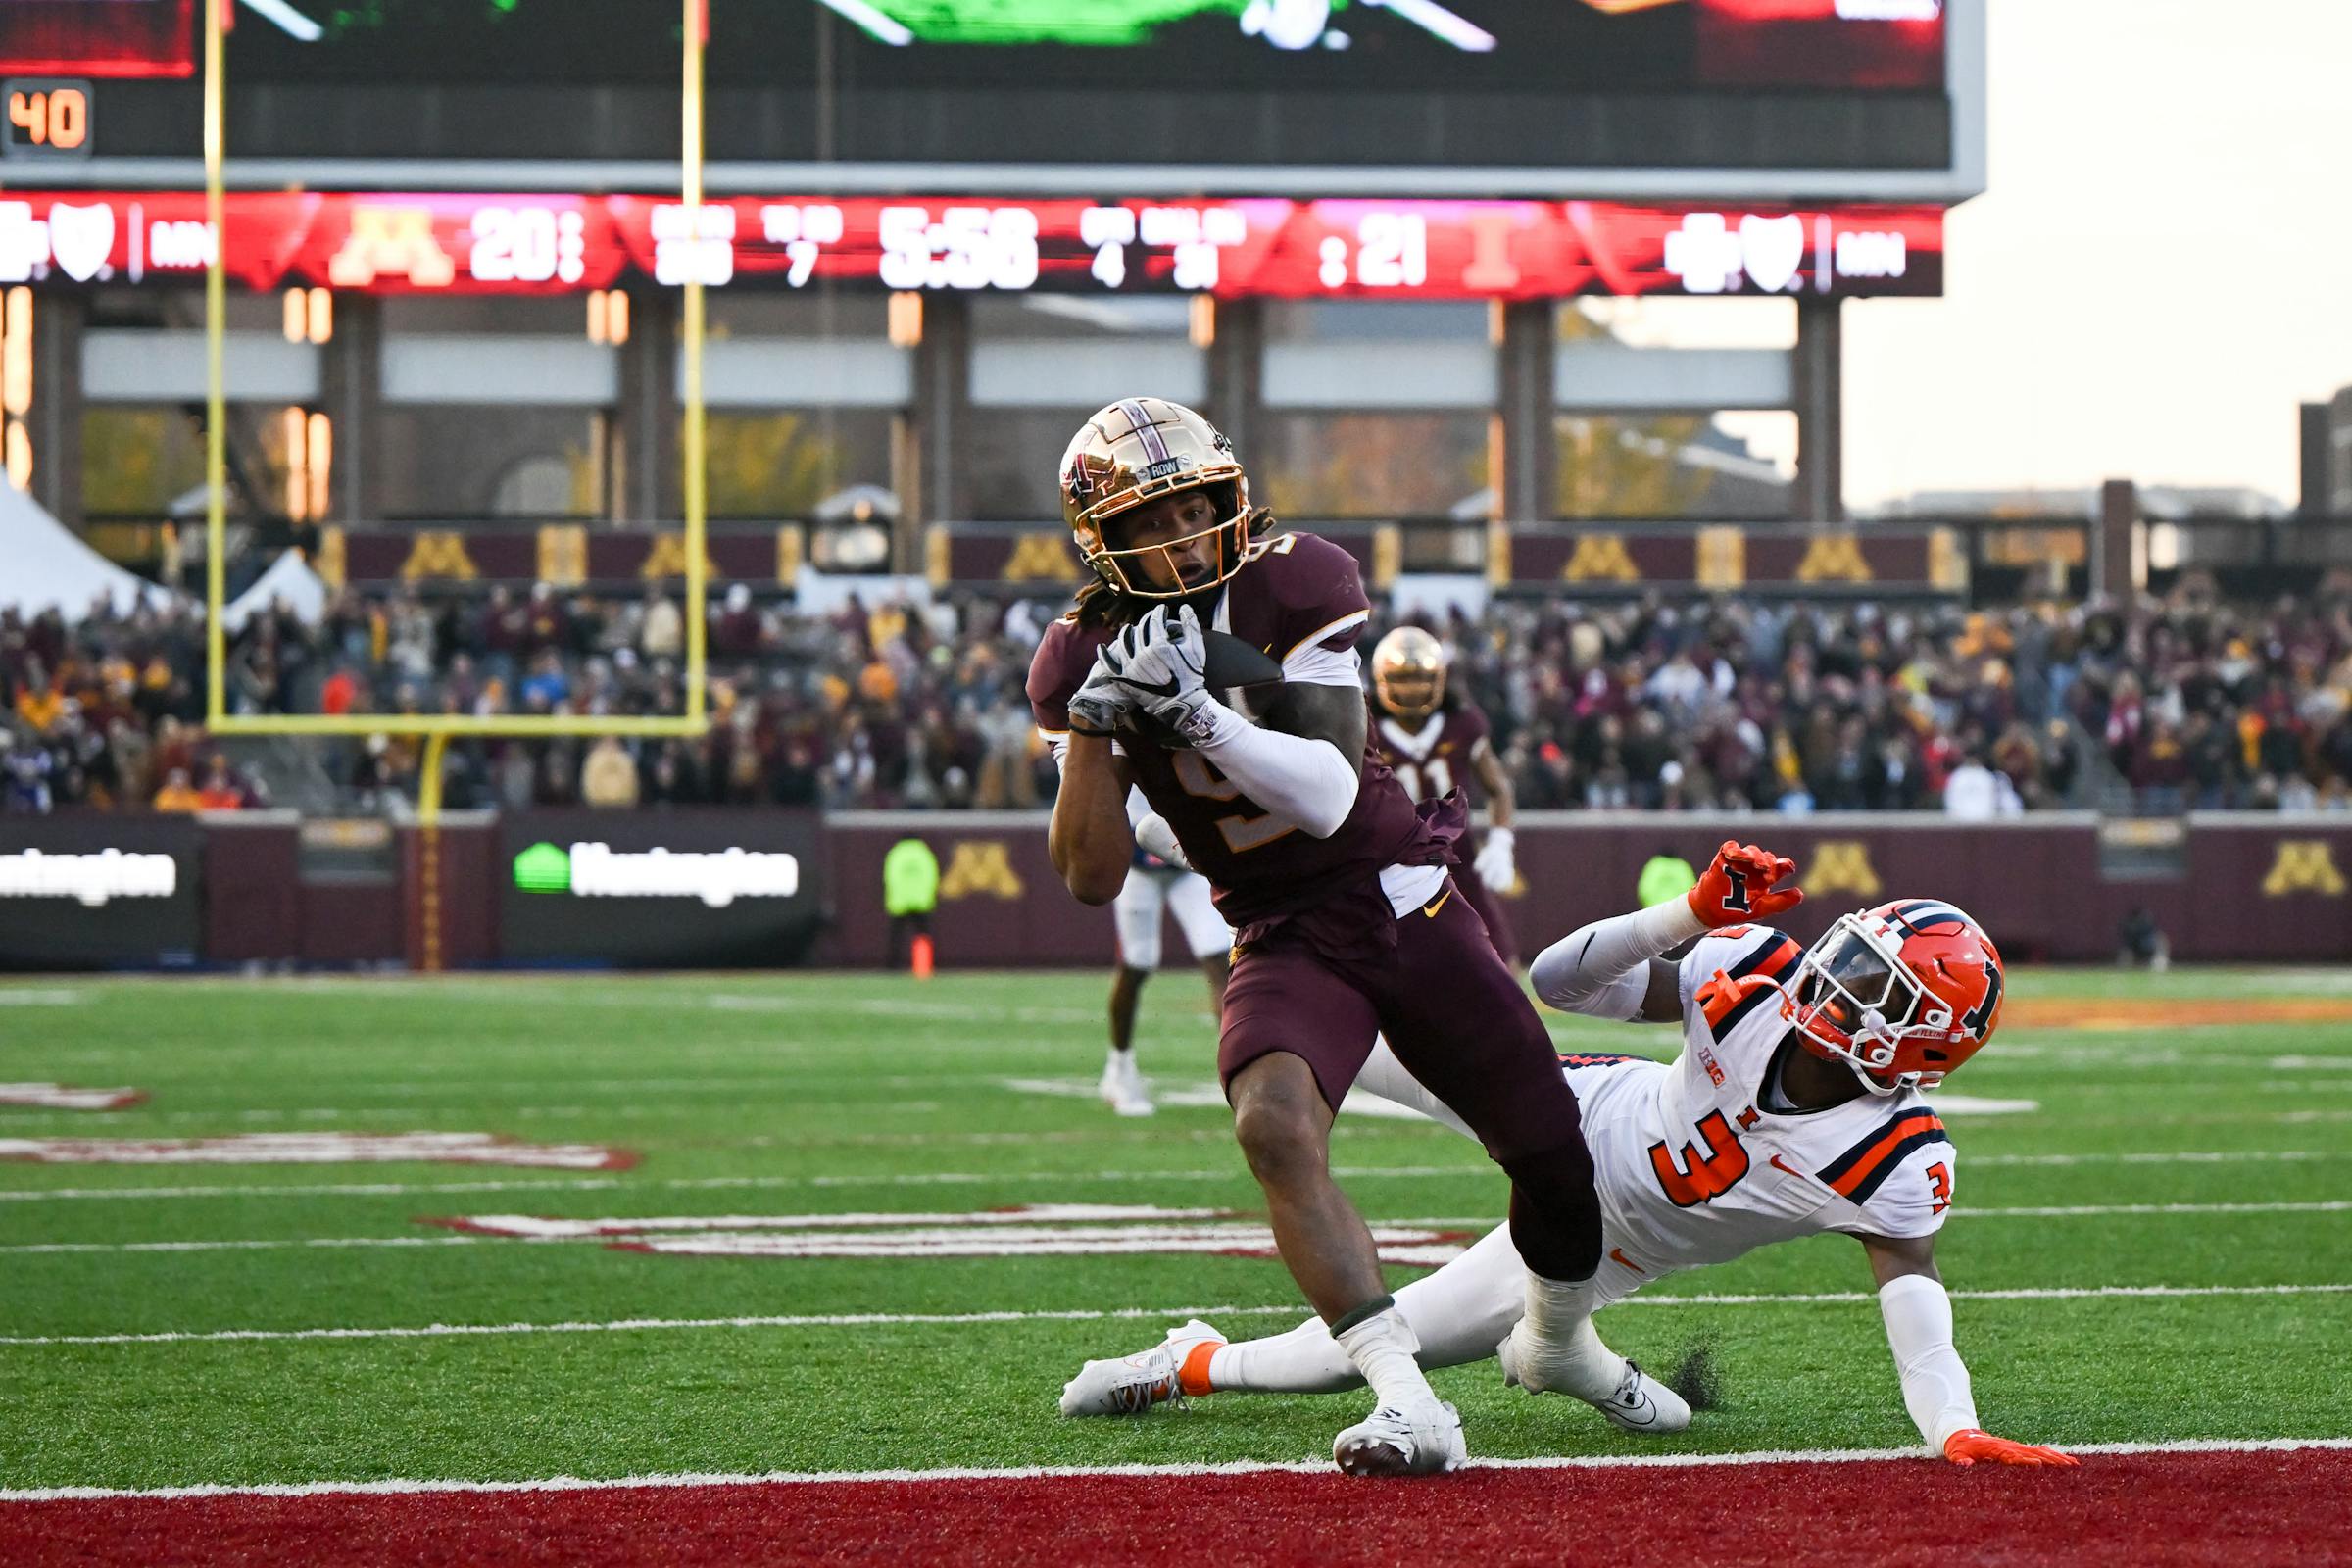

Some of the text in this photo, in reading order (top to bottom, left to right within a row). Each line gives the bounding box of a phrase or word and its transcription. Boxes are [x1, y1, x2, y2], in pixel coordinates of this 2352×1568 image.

[9, 88, 87, 149] 40
[328, 204, 456, 286] M
[470, 207, 557, 281] 20
[786, 241, 819, 288] 7
[1357, 213, 1427, 286] 21
[1152, 462, 1177, 478] ROW
[401, 532, 478, 580] M
[1004, 533, 1076, 581] M
[1563, 535, 1640, 581] M
[1796, 536, 1873, 582] M
[940, 840, 1023, 899] M
[1722, 863, 1752, 914] I
[1800, 840, 1884, 897] M
[2262, 839, 2346, 897] M
[1647, 1107, 1750, 1208] 3
[1926, 1161, 1952, 1216] 3
